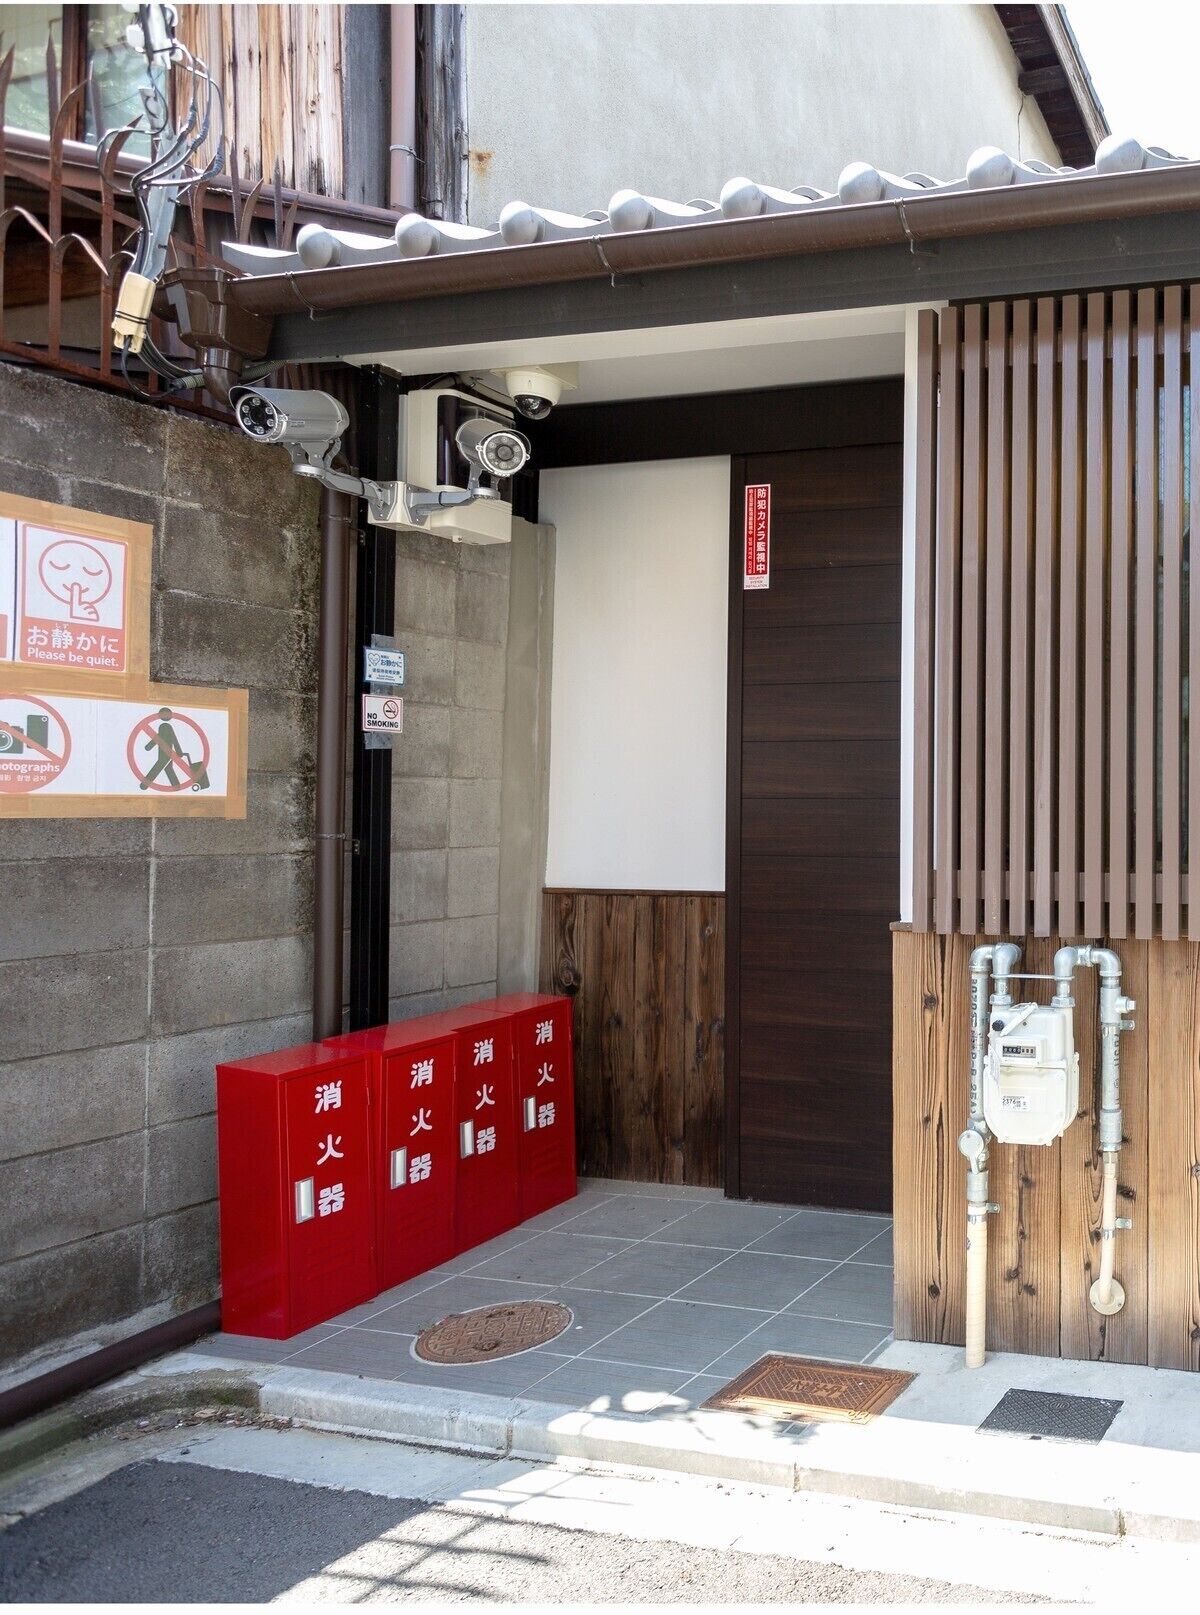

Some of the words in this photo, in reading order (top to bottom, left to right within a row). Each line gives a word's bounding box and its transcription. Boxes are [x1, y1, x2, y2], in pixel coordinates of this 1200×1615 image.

[757, 488, 766, 574] 防犯カメラ監視中
[27, 625, 119, 654] お静かに
[27, 647, 65, 661] Please
[69, 651, 84, 663] be
[86, 655, 119, 667] quiet.
[367, 712, 377, 720] NO
[367, 720, 399, 728] SMOKING
[0, 762, 60, 774] otographs
[473, 1038, 496, 1155] 消火器
[535, 1019, 556, 1128] 消火器
[315, 1080, 345, 1217] 消火器
[410, 1058, 434, 1184] 消火器
